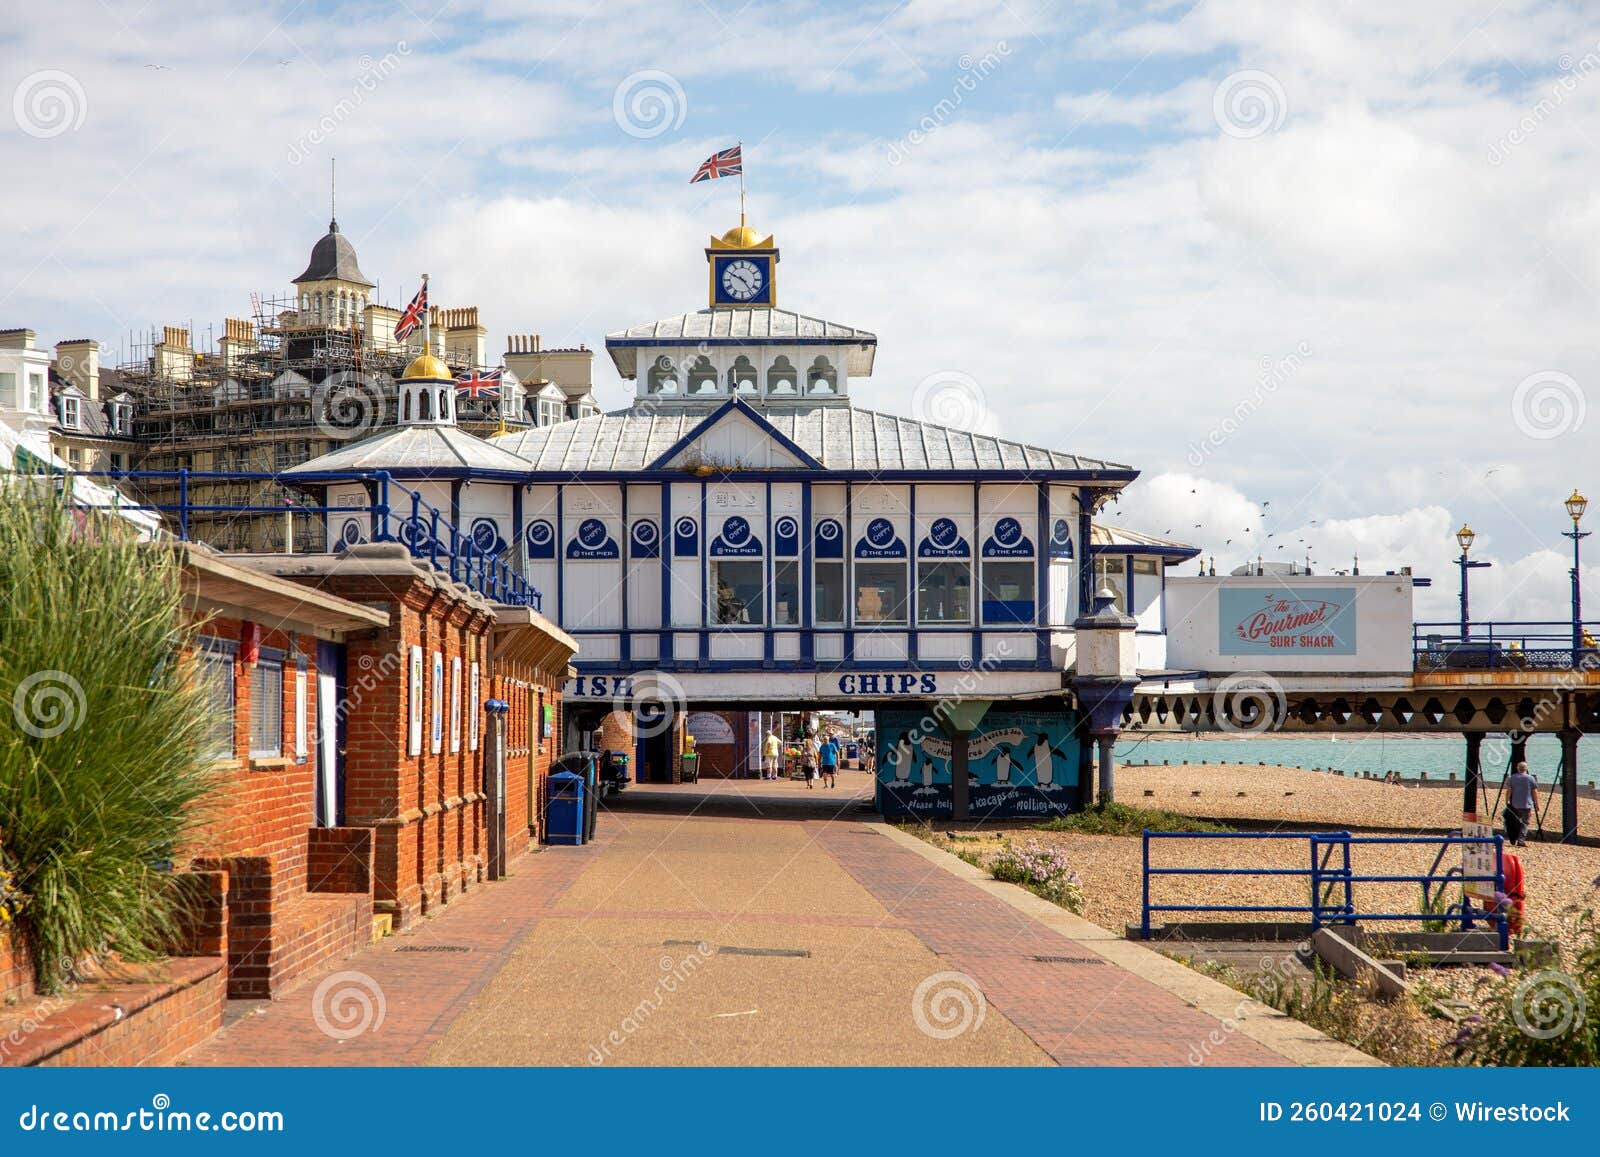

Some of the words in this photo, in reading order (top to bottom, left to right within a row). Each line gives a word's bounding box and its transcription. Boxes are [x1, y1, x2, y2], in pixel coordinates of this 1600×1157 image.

[1273, 600, 1290, 613] The
[1248, 601, 1327, 640] Gourmet
[1270, 636, 1297, 648] SURF
[1300, 635, 1335, 648] SHACK
[562, 676, 634, 697] ISH
[838, 673, 937, 695] CHIPS
